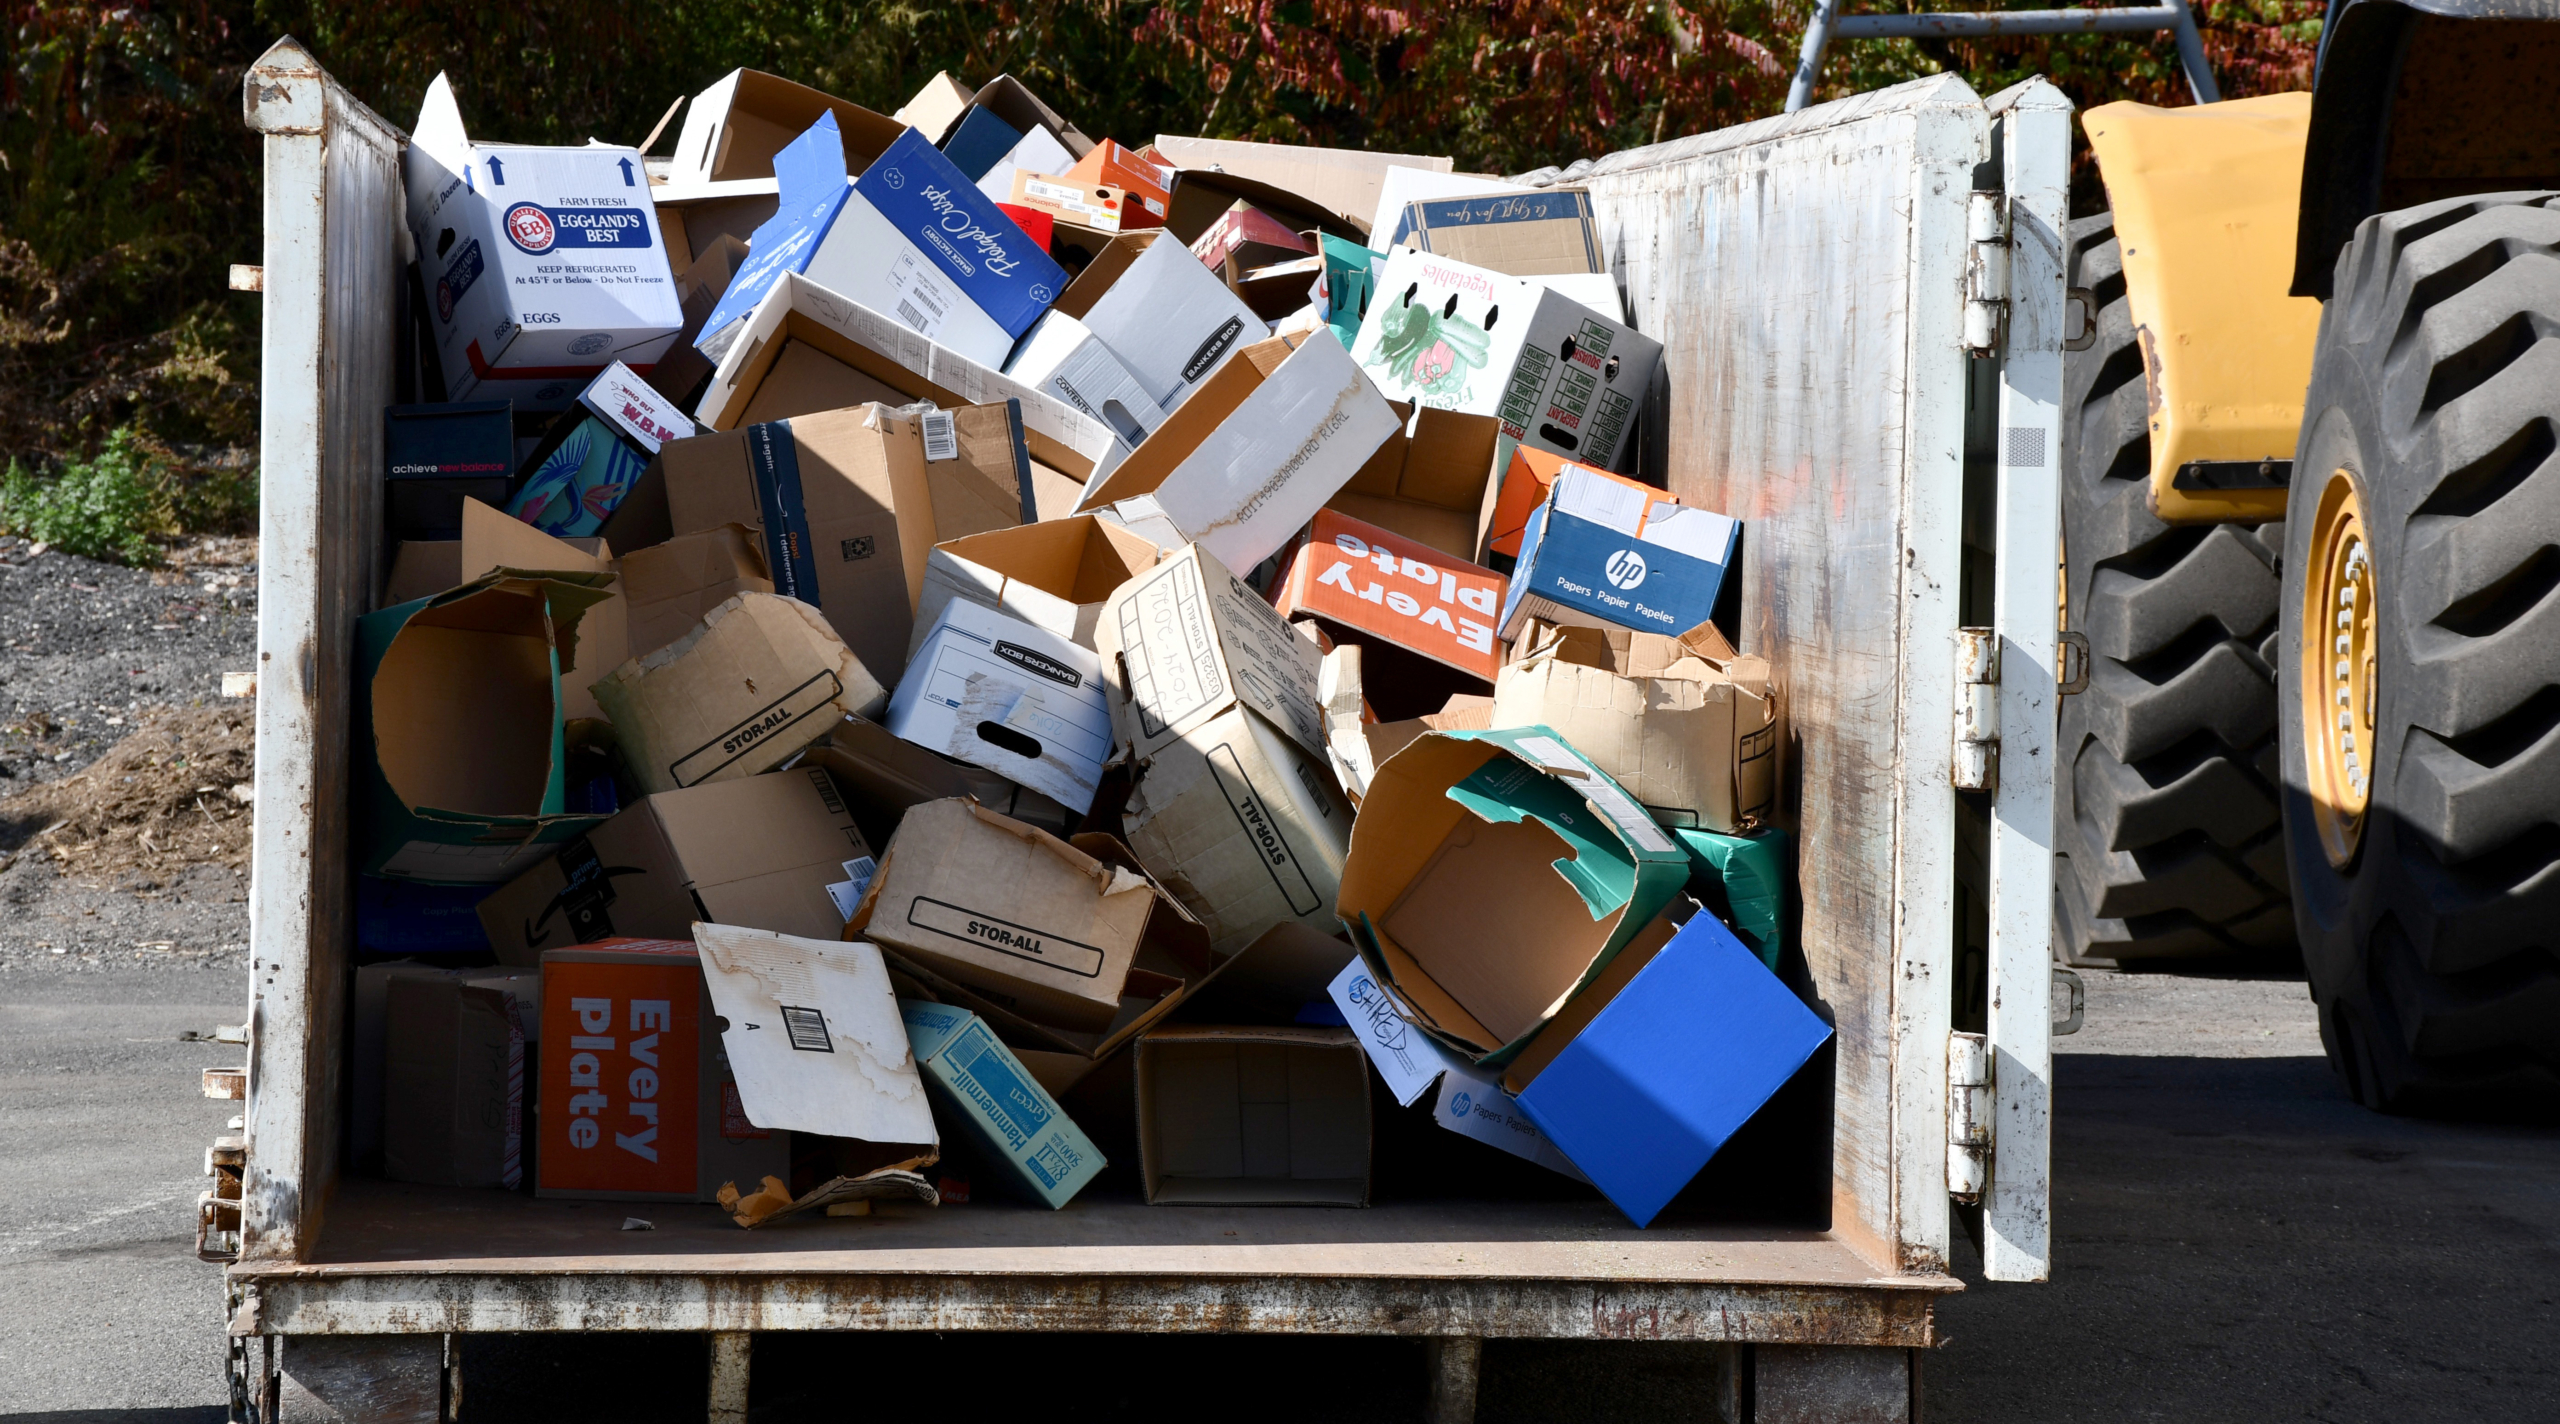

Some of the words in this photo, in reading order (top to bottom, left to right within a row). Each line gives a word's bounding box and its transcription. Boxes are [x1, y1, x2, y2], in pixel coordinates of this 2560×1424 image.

[440, 178, 461, 204] Dozen
[559, 197, 589, 206] FARM
[592, 198, 627, 206] FRESH
[920, 184, 971, 233] Crisps
[1024, 196, 1060, 210] balance
[1502, 196, 1531, 220] Gift
[510, 209, 541, 227] QUALITY
[518, 220, 543, 237] EB
[518, 226, 553, 248] APPROVED
[585, 229, 620, 242] BEST
[924, 229, 952, 256] FACTORY
[957, 225, 1020, 277] Pretzel
[951, 252, 973, 276] SNACK
[515, 276, 526, 284] At
[528, 276, 550, 284] 45°F
[565, 276, 592, 284] Below
[601, 276, 614, 284] Do
[616, 276, 632, 284] Not
[635, 276, 664, 284] Freeze
[1421, 263, 1494, 302] Vegetables
[494, 318, 511, 341] EGGS
[522, 313, 561, 324] EGGS
[1187, 340, 1222, 378] BANKERS
[1220, 322, 1239, 341] BOX
[1526, 348, 1546, 363] SUNTAN
[1571, 347, 1601, 370] SQUASH
[1589, 340, 1605, 355] ACORN
[1515, 369, 1536, 386] MEDIUM
[1522, 359, 1542, 374] SELECT
[1514, 384, 1531, 399] LARGE
[1575, 372, 1594, 388] CHOICE
[622, 386, 639, 401] WHO
[640, 401, 655, 414] BUT
[625, 369, 641, 385] INKJET
[643, 386, 659, 400] LASER
[661, 400, 671, 410] FAX
[673, 412, 686, 424] COPY
[1506, 394, 1523, 410] LARGE
[1566, 399, 1583, 415] FANCY
[1615, 395, 1629, 409] PLAIN
[618, 413, 627, 422] FOR
[627, 421, 642, 433] OFFICE
[1503, 407, 1522, 423] JUMBO
[1546, 406, 1580, 429] EGGPLANT
[1602, 416, 1621, 432] SELECT
[1609, 407, 1625, 420] LARGE
[1319, 411, 1350, 442] R16RL
[1600, 428, 1617, 444] SMALL
[1588, 448, 1607, 464] SUPER
[1592, 439, 1612, 455] SELECT
[392, 464, 438, 474] achieve
[460, 462, 505, 472] balance
[788, 532, 800, 559] Oops!
[780, 539, 794, 585] delivered
[1608, 549, 1644, 589] hp
[1335, 533, 1497, 618] Plate
[1317, 560, 1494, 656] Every
[1557, 577, 1592, 597] Papers
[1597, 591, 1630, 609] Papier
[1635, 603, 1675, 624] Papeles
[1000, 645, 1024, 661] BOX
[1024, 655, 1076, 683] BANKERS
[1200, 654, 1220, 694] 03325
[1559, 813, 1574, 825] B
[571, 856, 599, 881] prime
[423, 907, 449, 916] Copy
[451, 906, 474, 914] Plus
[967, 921, 1043, 954] STOR-ALL
[1349, 977, 1407, 1052] SHRED
[745, 1022, 761, 1031] A
[568, 997, 615, 1149] Plate
[615, 999, 671, 1164] Every
[953, 1071, 1029, 1152] Hammermill
[1008, 1086, 1048, 1124] Green
[1452, 1093, 1471, 1117] hp
[1473, 1104, 1502, 1123] Papers
[1506, 1118, 1536, 1136] Papiers
[1035, 1143, 1053, 1160] 11
[1059, 1144, 1082, 1168] 5000
[1028, 1159, 1054, 1186] LETTER
